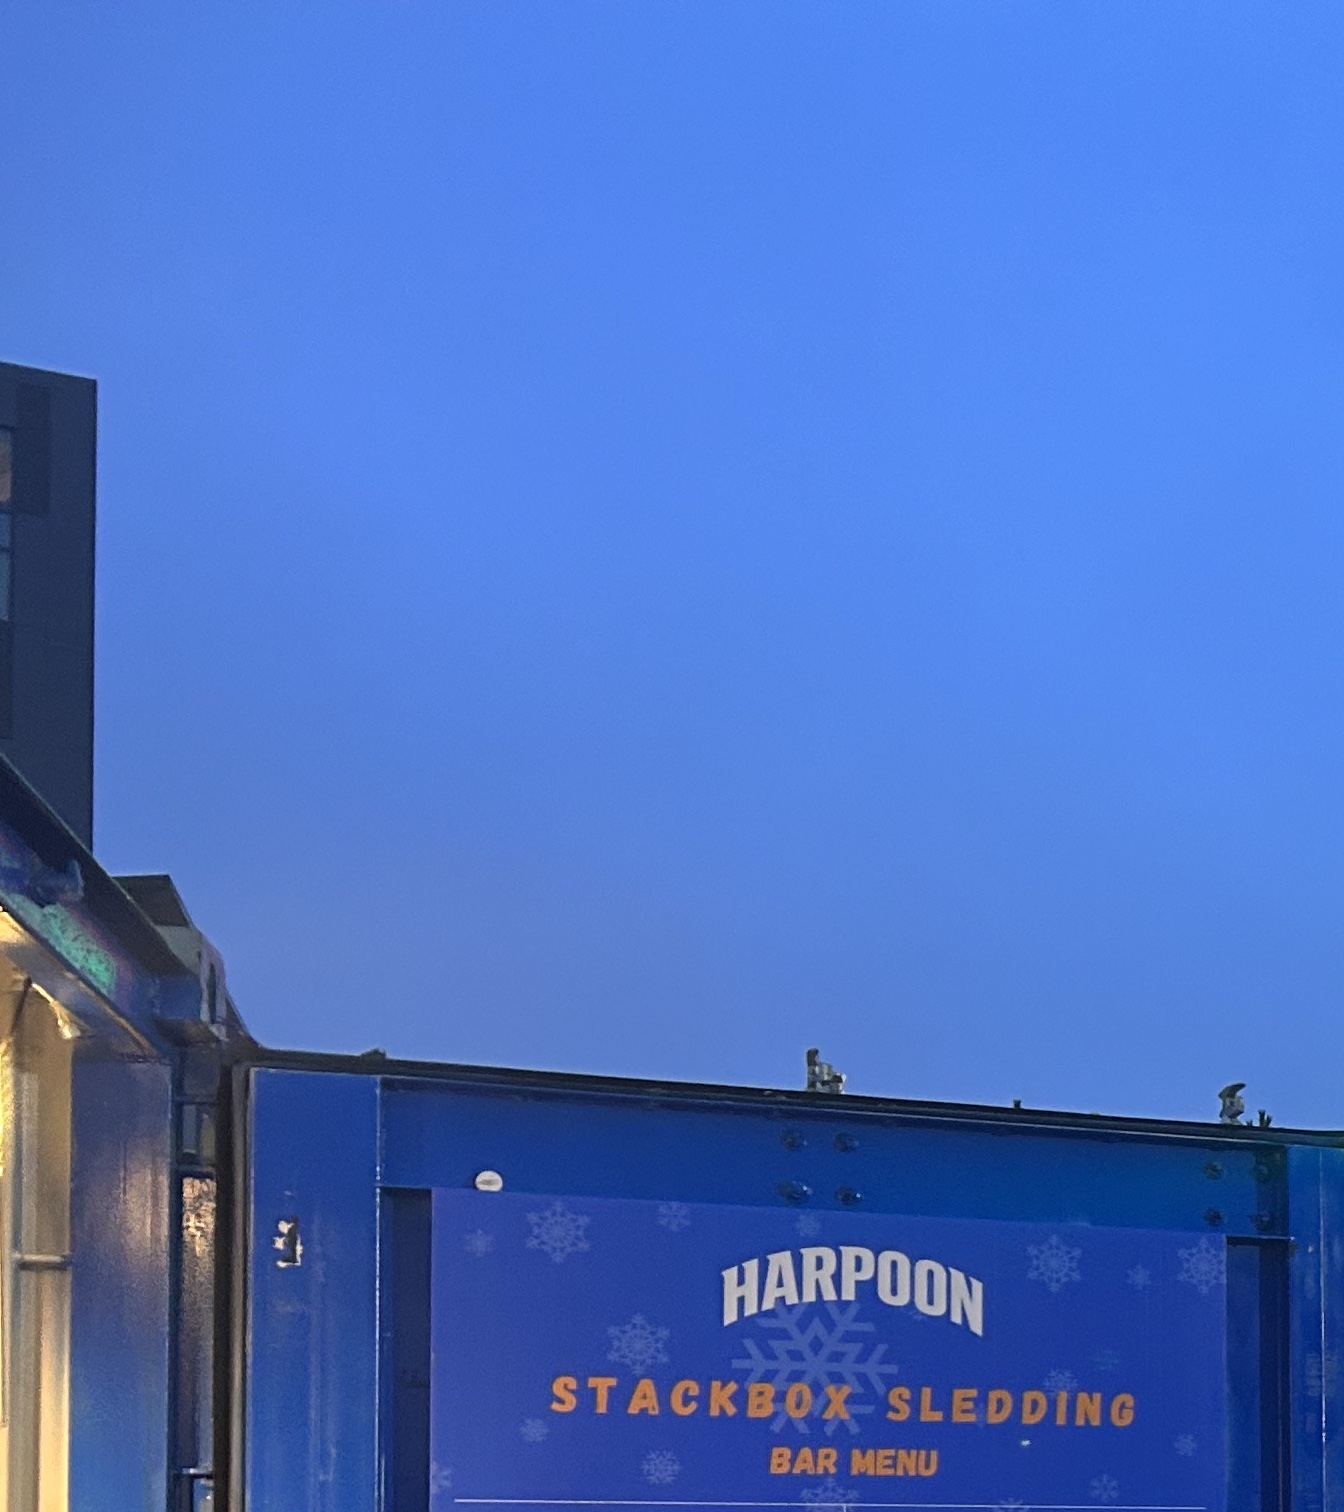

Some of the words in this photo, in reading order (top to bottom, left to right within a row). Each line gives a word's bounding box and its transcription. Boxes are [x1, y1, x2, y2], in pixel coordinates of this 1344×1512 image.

[721, 1245, 984, 1336] HARPOON
[551, 1376, 850, 1422] STACKBOX
[887, 1387, 1137, 1428] SLEDDING
[770, 1448, 838, 1475] BAR
[851, 1450, 940, 1477] MENU
